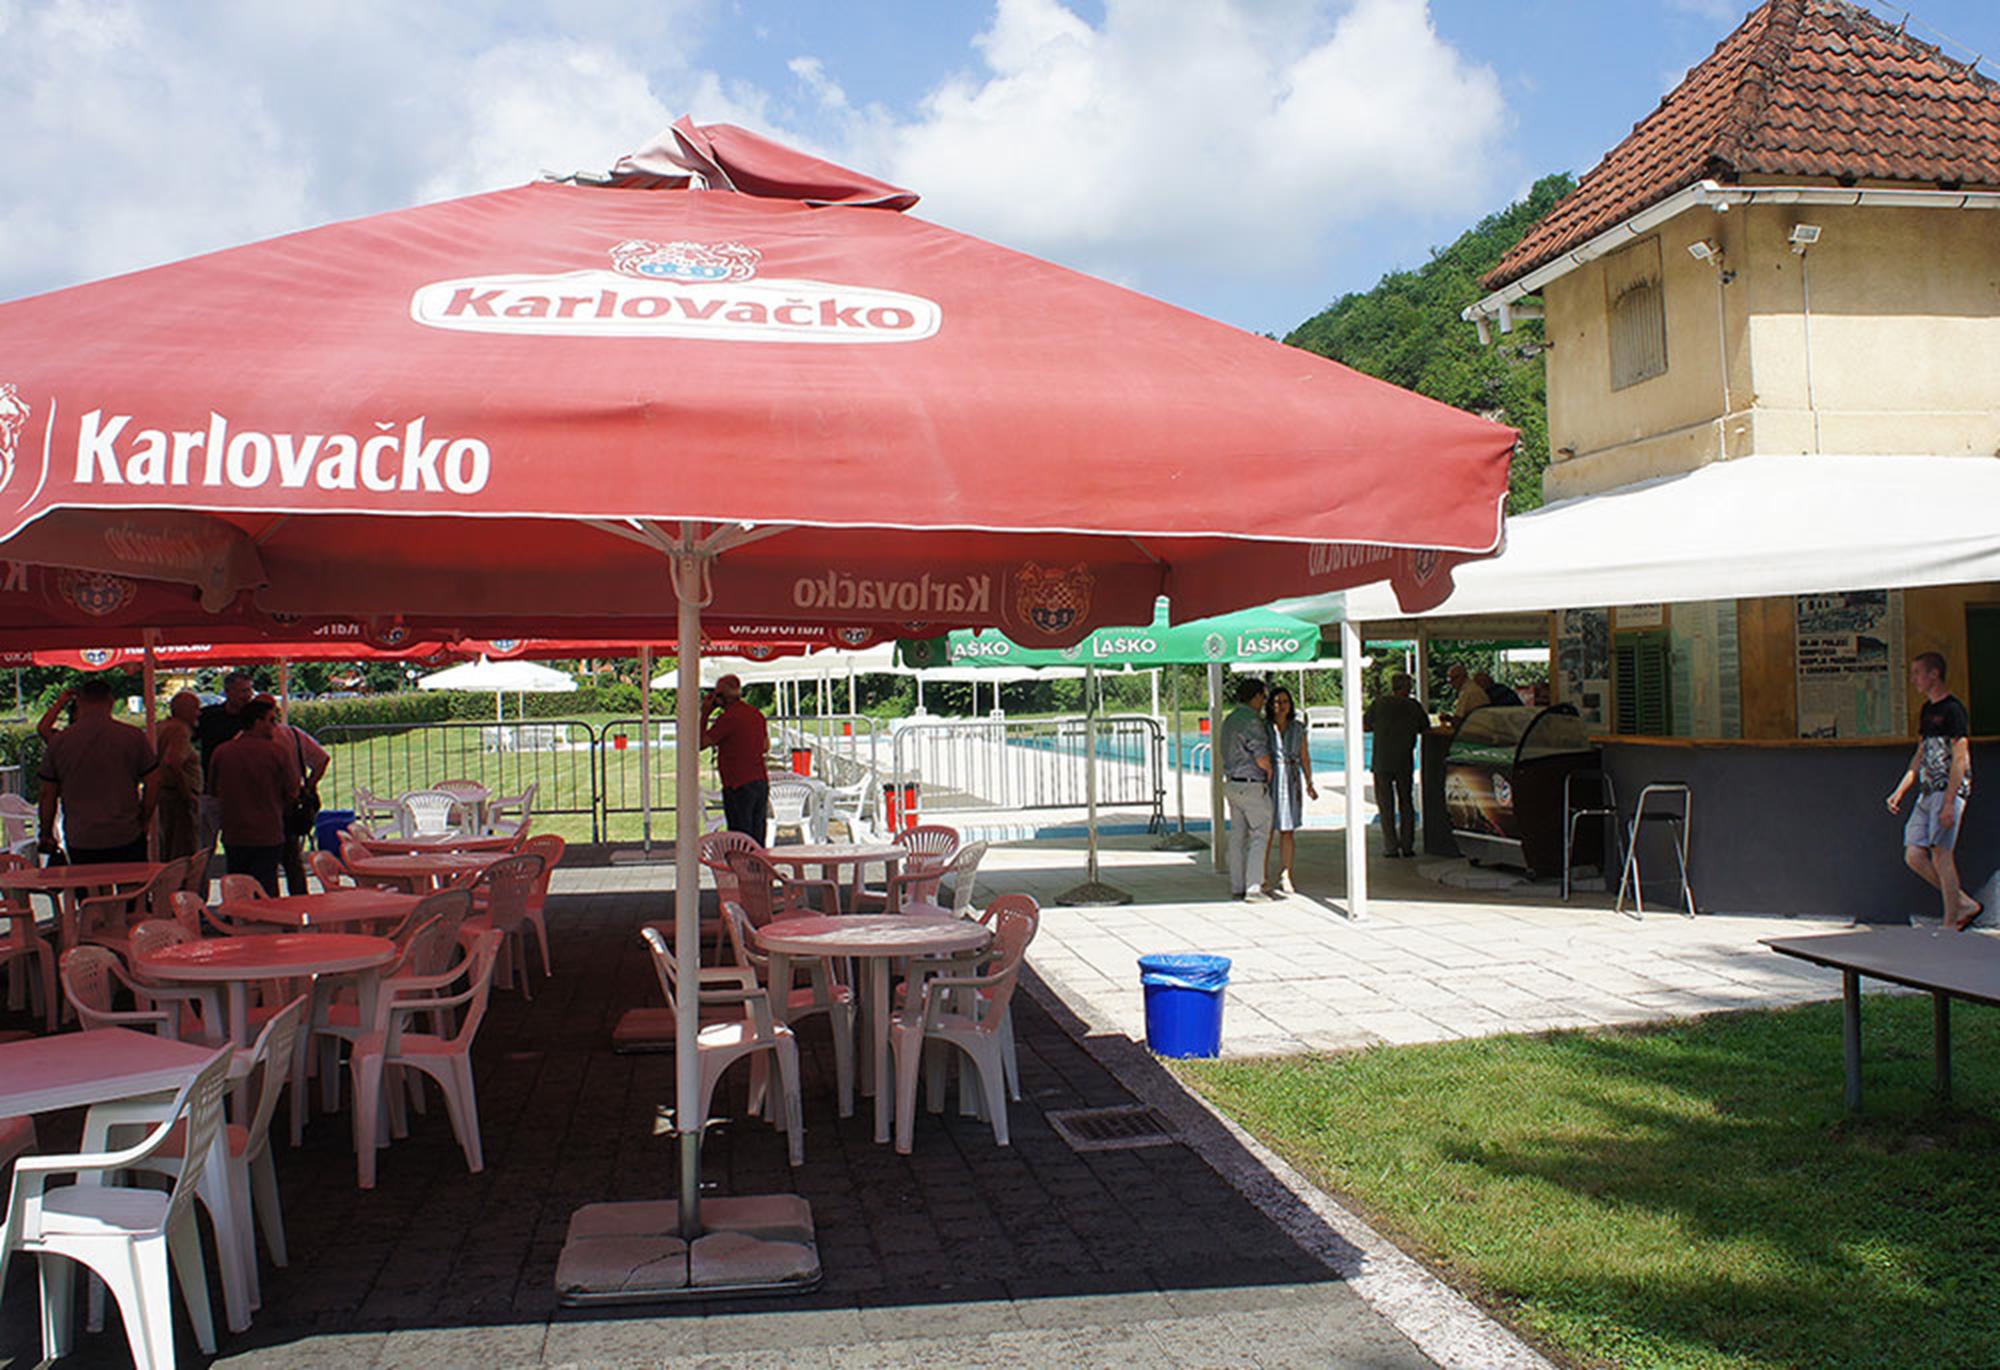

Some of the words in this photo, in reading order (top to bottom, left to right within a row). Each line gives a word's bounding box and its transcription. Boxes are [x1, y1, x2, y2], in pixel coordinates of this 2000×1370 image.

[443, 287, 916, 330] Karlovačko
[73, 408, 491, 494] Karlovačko
[1093, 636, 1158, 658] LAŠKO
[1237, 635, 1300, 657] LAŠKO
